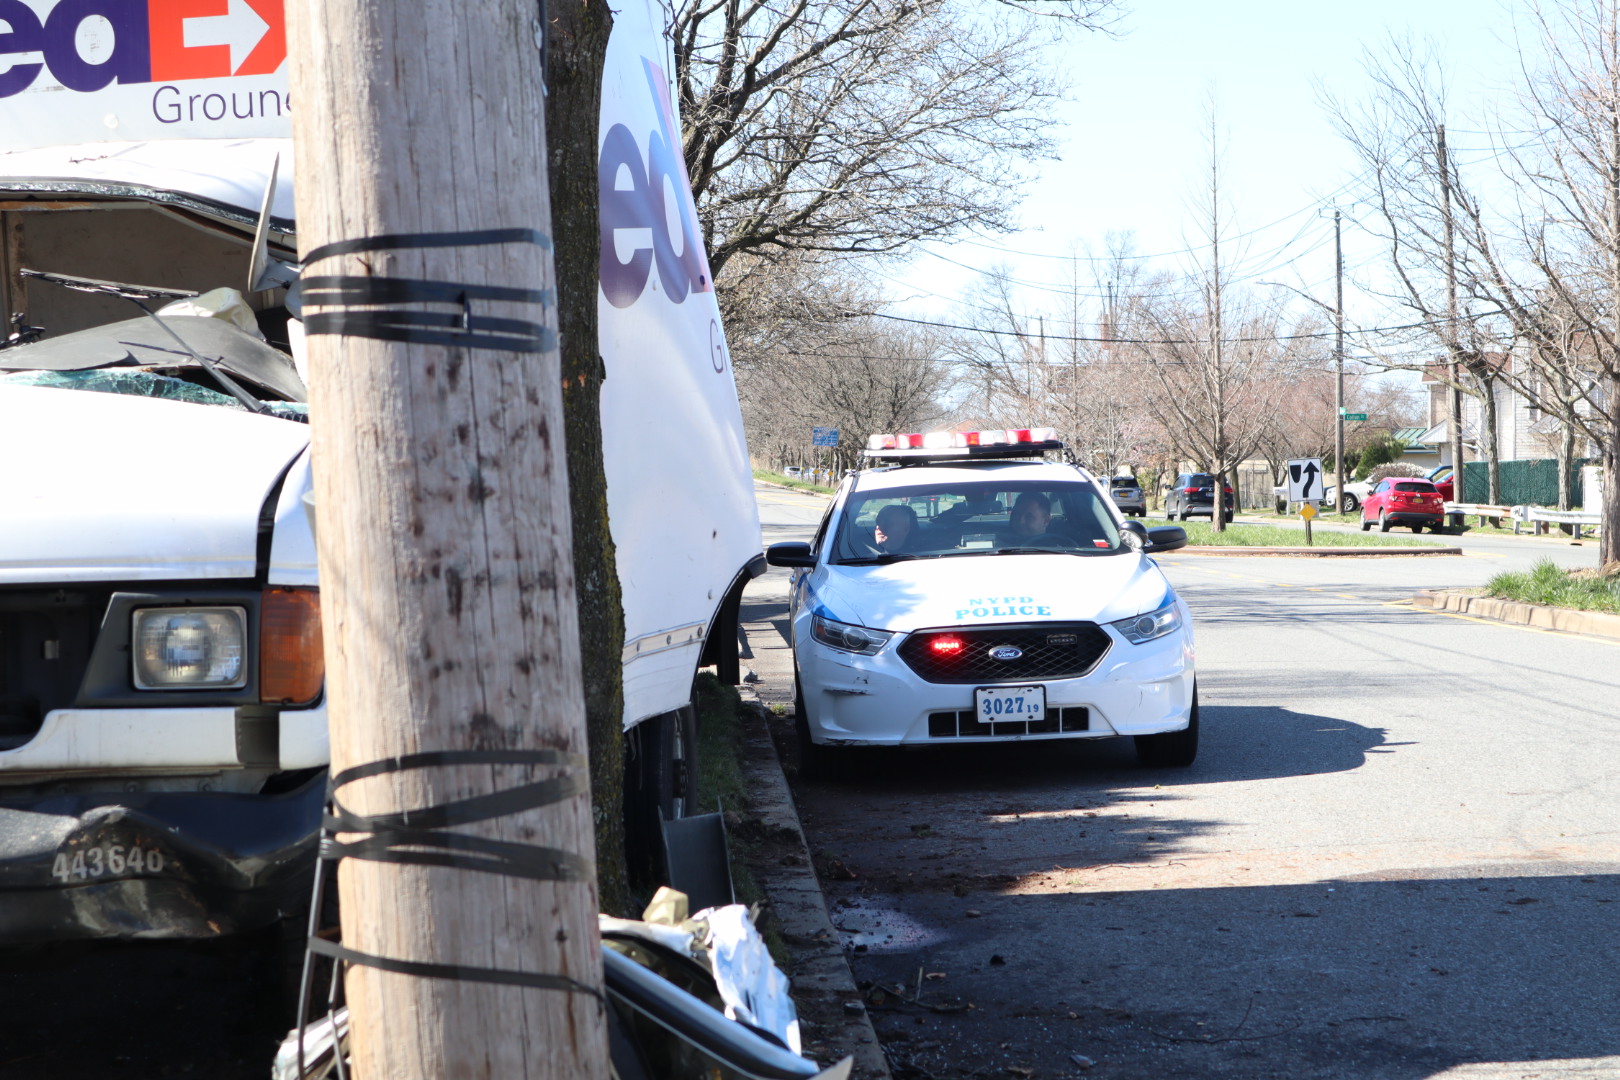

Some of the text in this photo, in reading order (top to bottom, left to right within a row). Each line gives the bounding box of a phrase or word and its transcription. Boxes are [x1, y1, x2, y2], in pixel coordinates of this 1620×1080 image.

[152, 85, 292, 124] Groun
[968, 596, 1034, 606] NYPD
[954, 605, 1052, 620] POLICE
[997, 649, 1016, 658] Ford
[982, 696, 1040, 716] 3027 19
[52, 845, 164, 883] 443640
